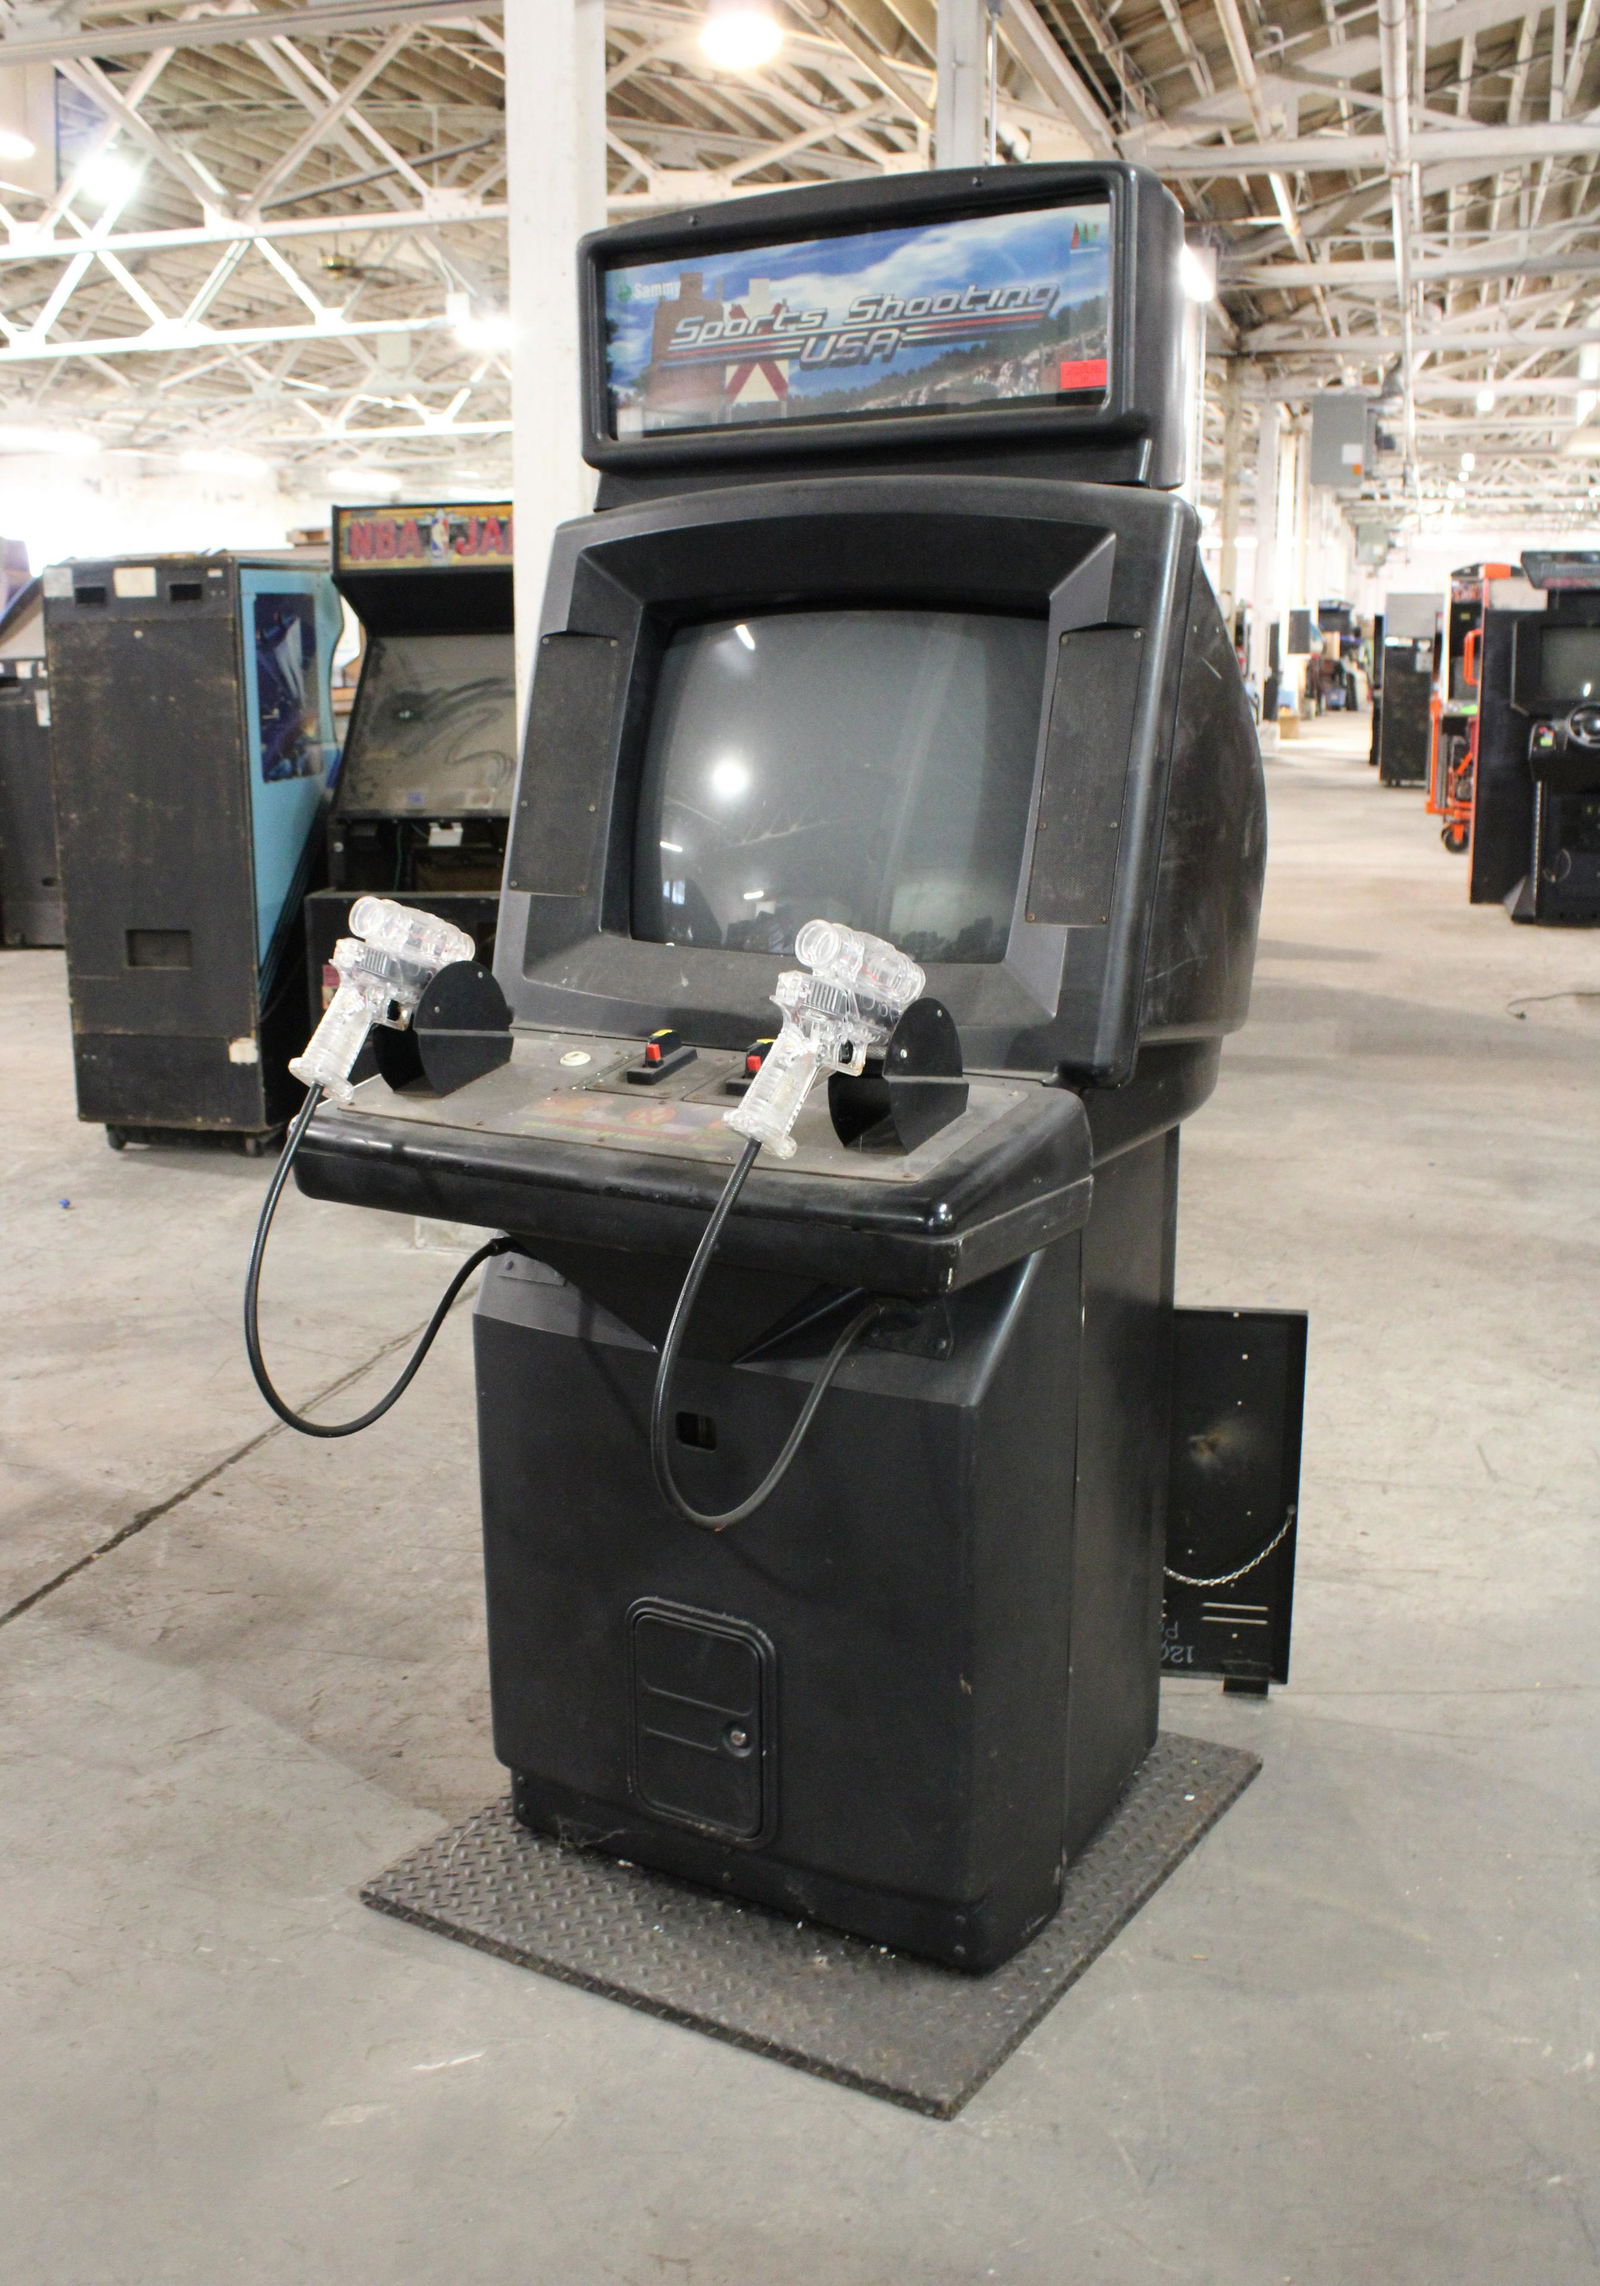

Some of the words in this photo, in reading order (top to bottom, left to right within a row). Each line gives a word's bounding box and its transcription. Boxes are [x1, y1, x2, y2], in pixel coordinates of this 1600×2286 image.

[633, 281, 681, 301] Sammy
[671, 306, 827, 347] Sports
[846, 284, 1060, 324] Shooting
[800, 328, 900, 367] USA
[350, 518, 424, 559] NBA
